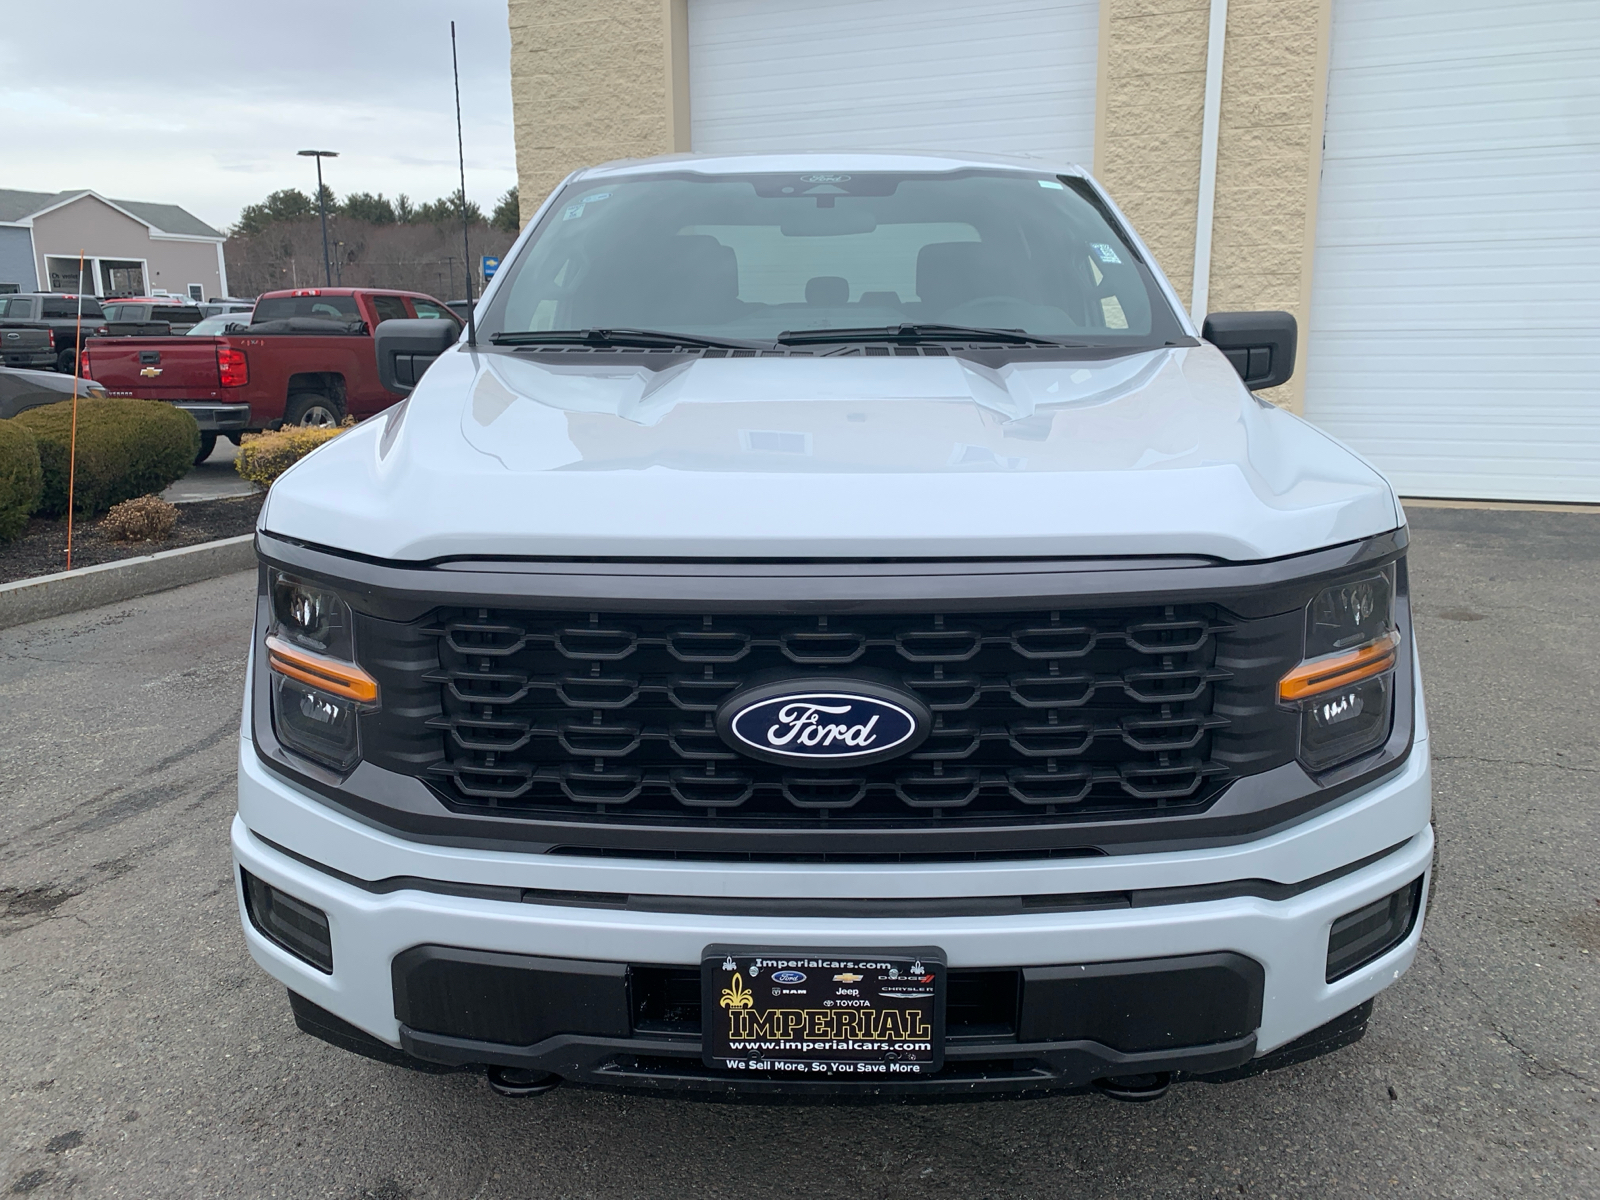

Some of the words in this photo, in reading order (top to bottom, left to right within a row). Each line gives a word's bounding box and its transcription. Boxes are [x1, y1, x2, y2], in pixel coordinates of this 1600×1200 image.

[767, 702, 880, 747] Ford
[755, 958, 892, 970] Imperialcars.com
[836, 987, 859, 997] Jeep
[729, 1009, 931, 1040] IMPERIAL
[729, 1040, 931, 1051] www.imperialcars.com
[726, 1060, 746, 1070] We
[748, 1060, 771, 1070] Sell
[774, 1061, 808, 1072] More,
[811, 1062, 827, 1072] So
[830, 1062, 854, 1072] You
[856, 1063, 886, 1073] Save
[889, 1063, 920, 1073] More
